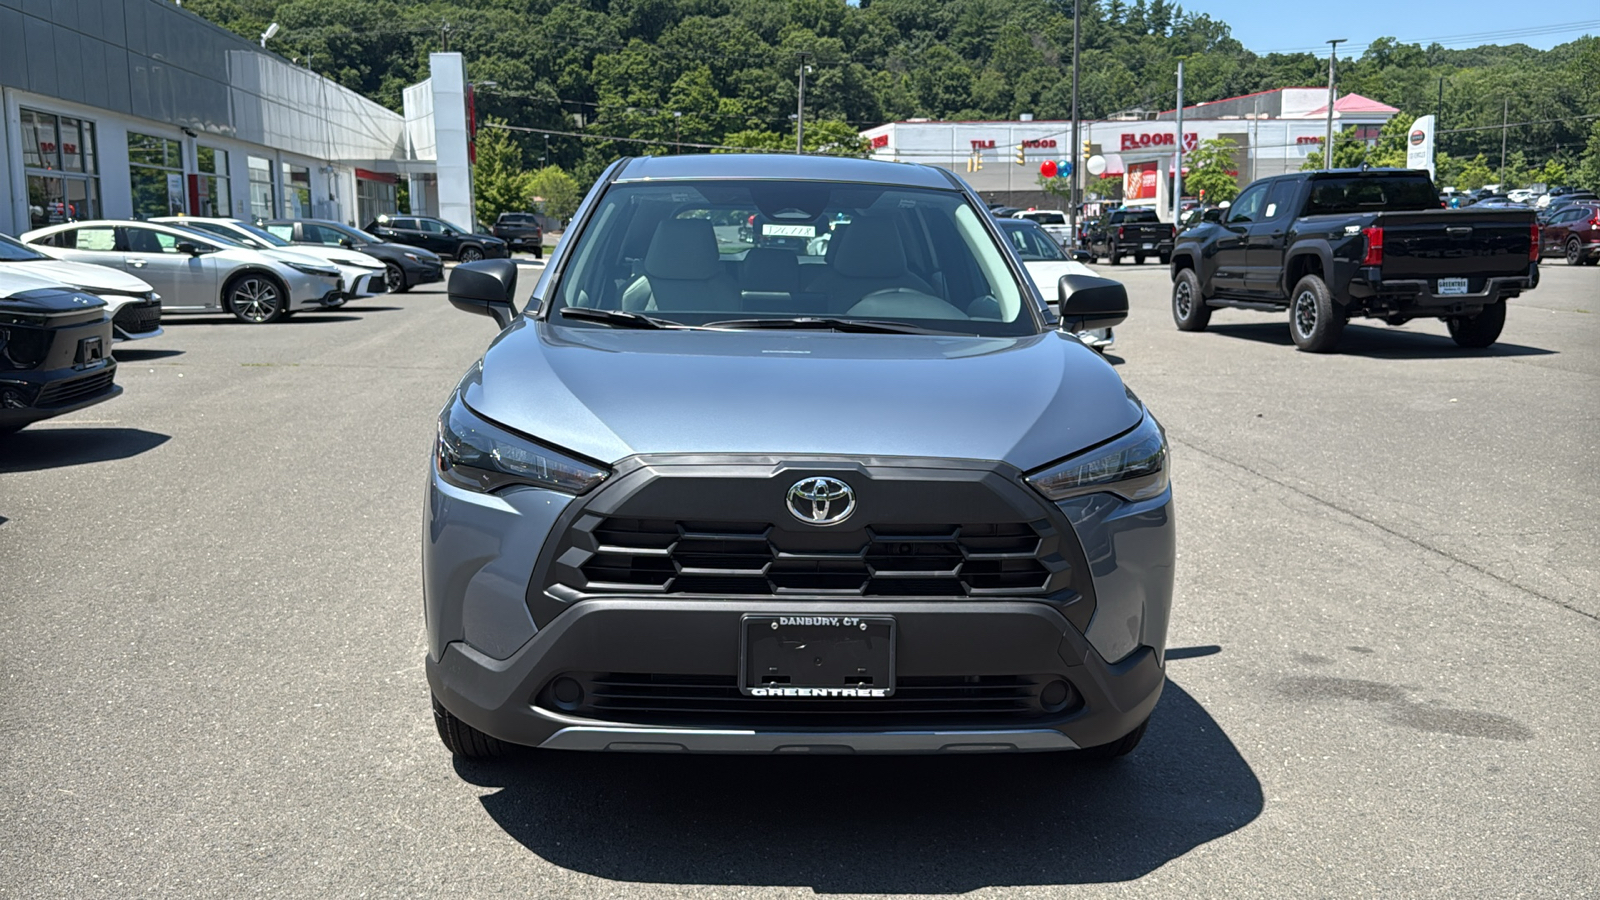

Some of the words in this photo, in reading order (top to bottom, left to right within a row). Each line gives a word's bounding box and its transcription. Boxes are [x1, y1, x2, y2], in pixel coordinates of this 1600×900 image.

[970, 140, 996, 149] TILE
[1021, 139, 1057, 149] WOOD
[1121, 133, 1174, 146] FLOOR
[779, 617, 840, 627] DANBURY,
[843, 617, 860, 626] CT
[751, 688, 886, 697] GREENTREE
